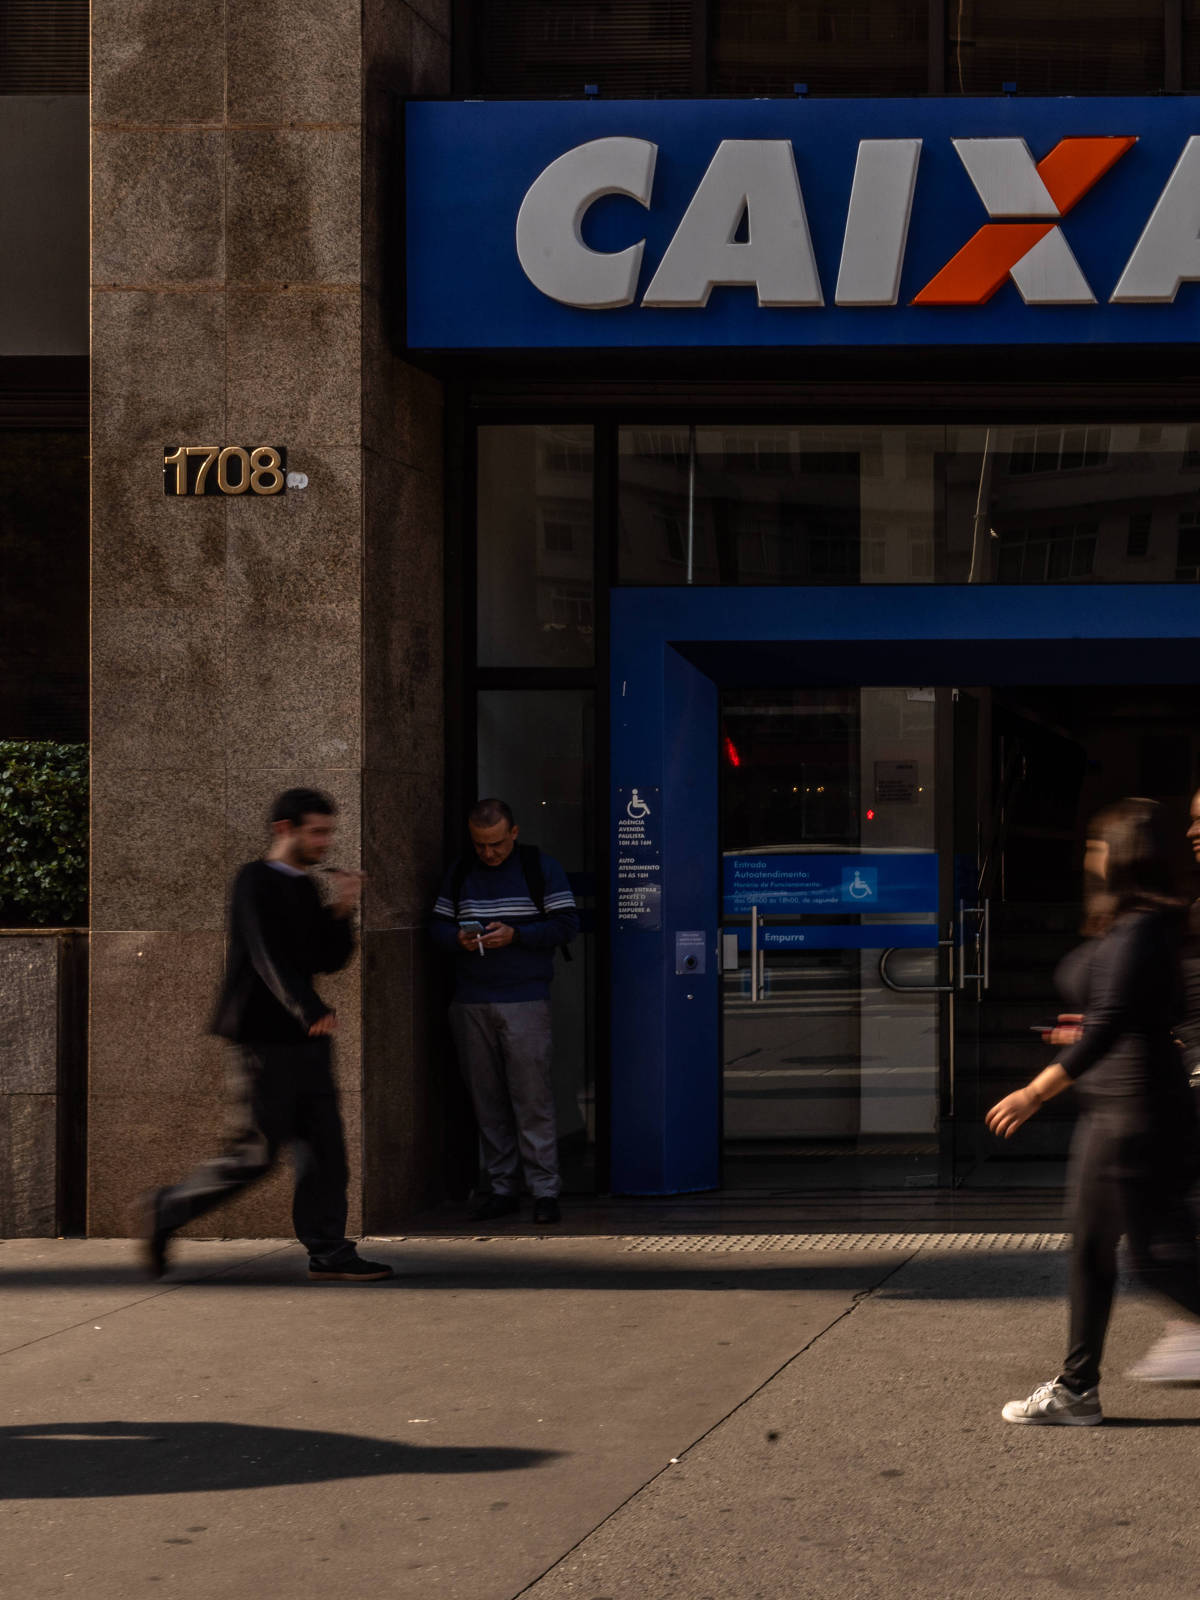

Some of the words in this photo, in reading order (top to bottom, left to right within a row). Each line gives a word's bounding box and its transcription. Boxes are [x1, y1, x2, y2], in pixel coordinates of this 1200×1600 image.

[164, 446, 285, 496] 1708
[734, 861, 767, 869] Entrada
[764, 933, 805, 943] Empurre
